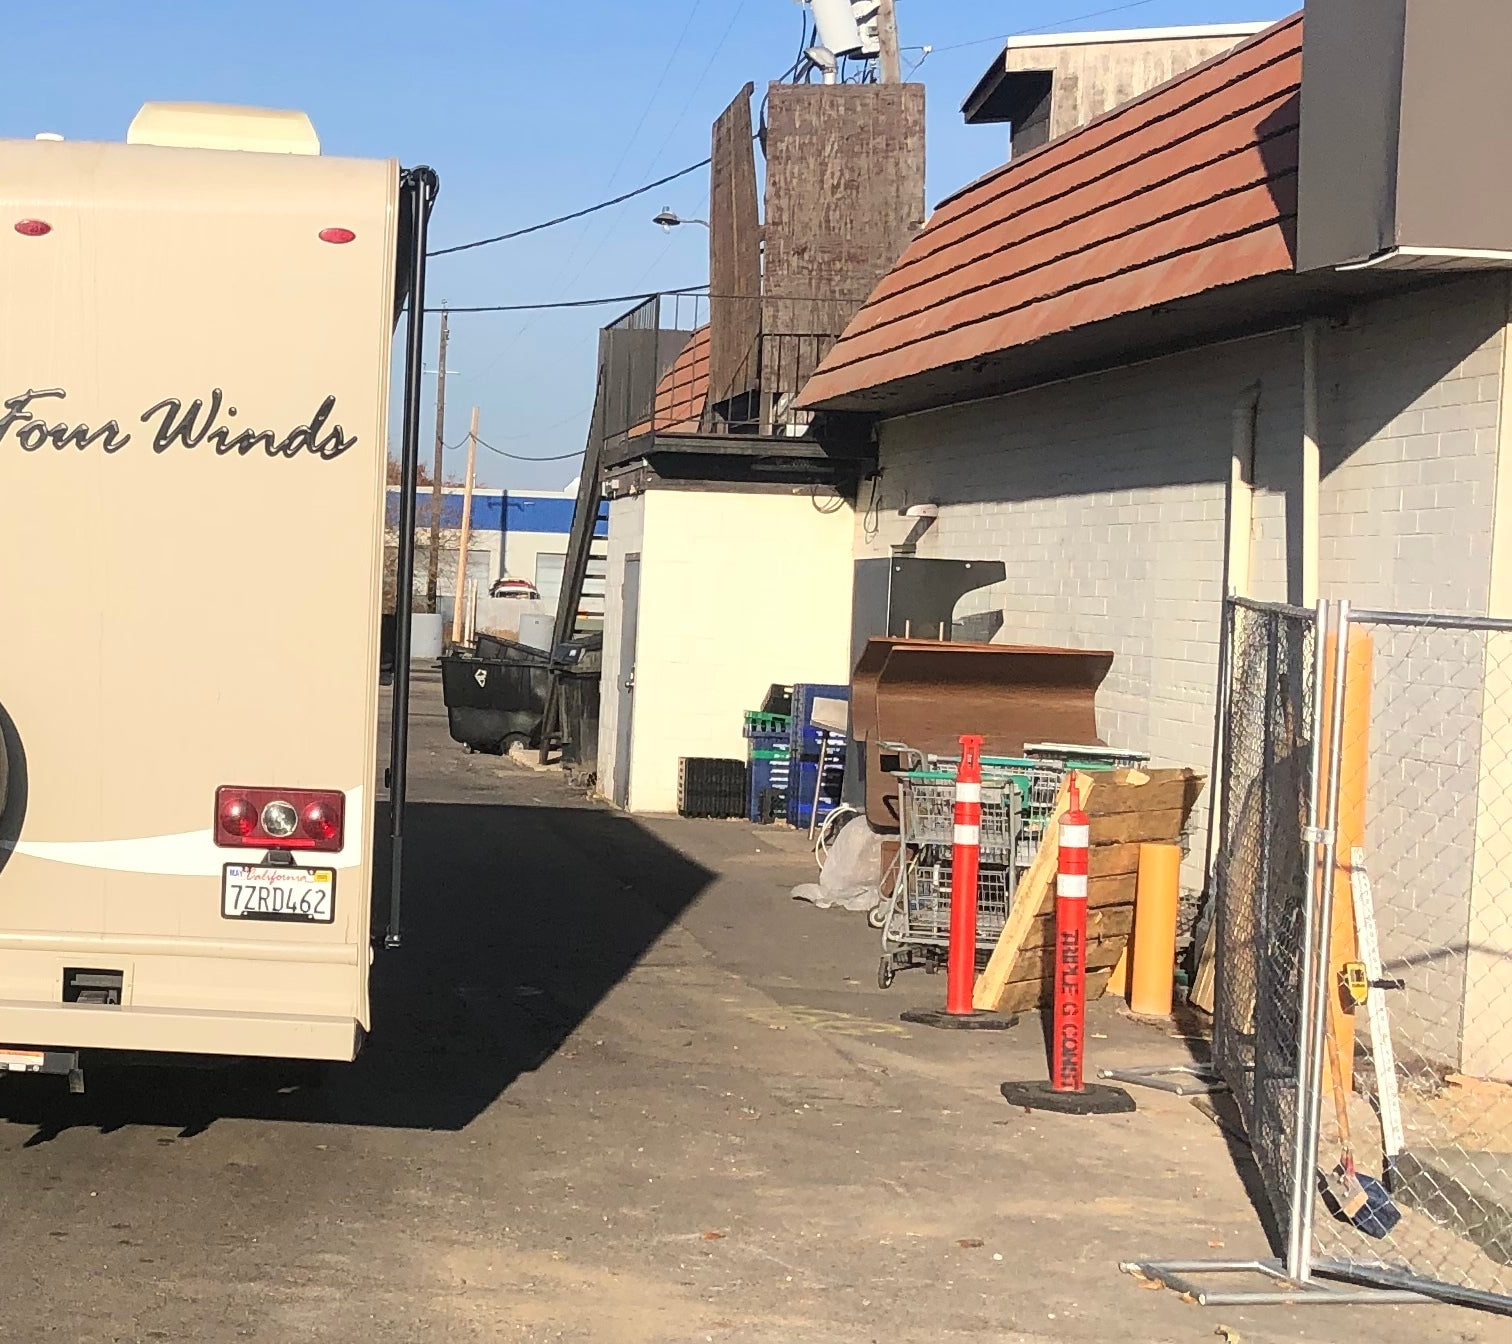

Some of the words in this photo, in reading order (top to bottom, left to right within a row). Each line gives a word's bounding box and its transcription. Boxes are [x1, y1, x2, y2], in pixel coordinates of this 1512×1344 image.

[140, 387, 358, 460] Winds
[246, 866, 314, 885] California
[230, 884, 327, 915] 7ZRD462
